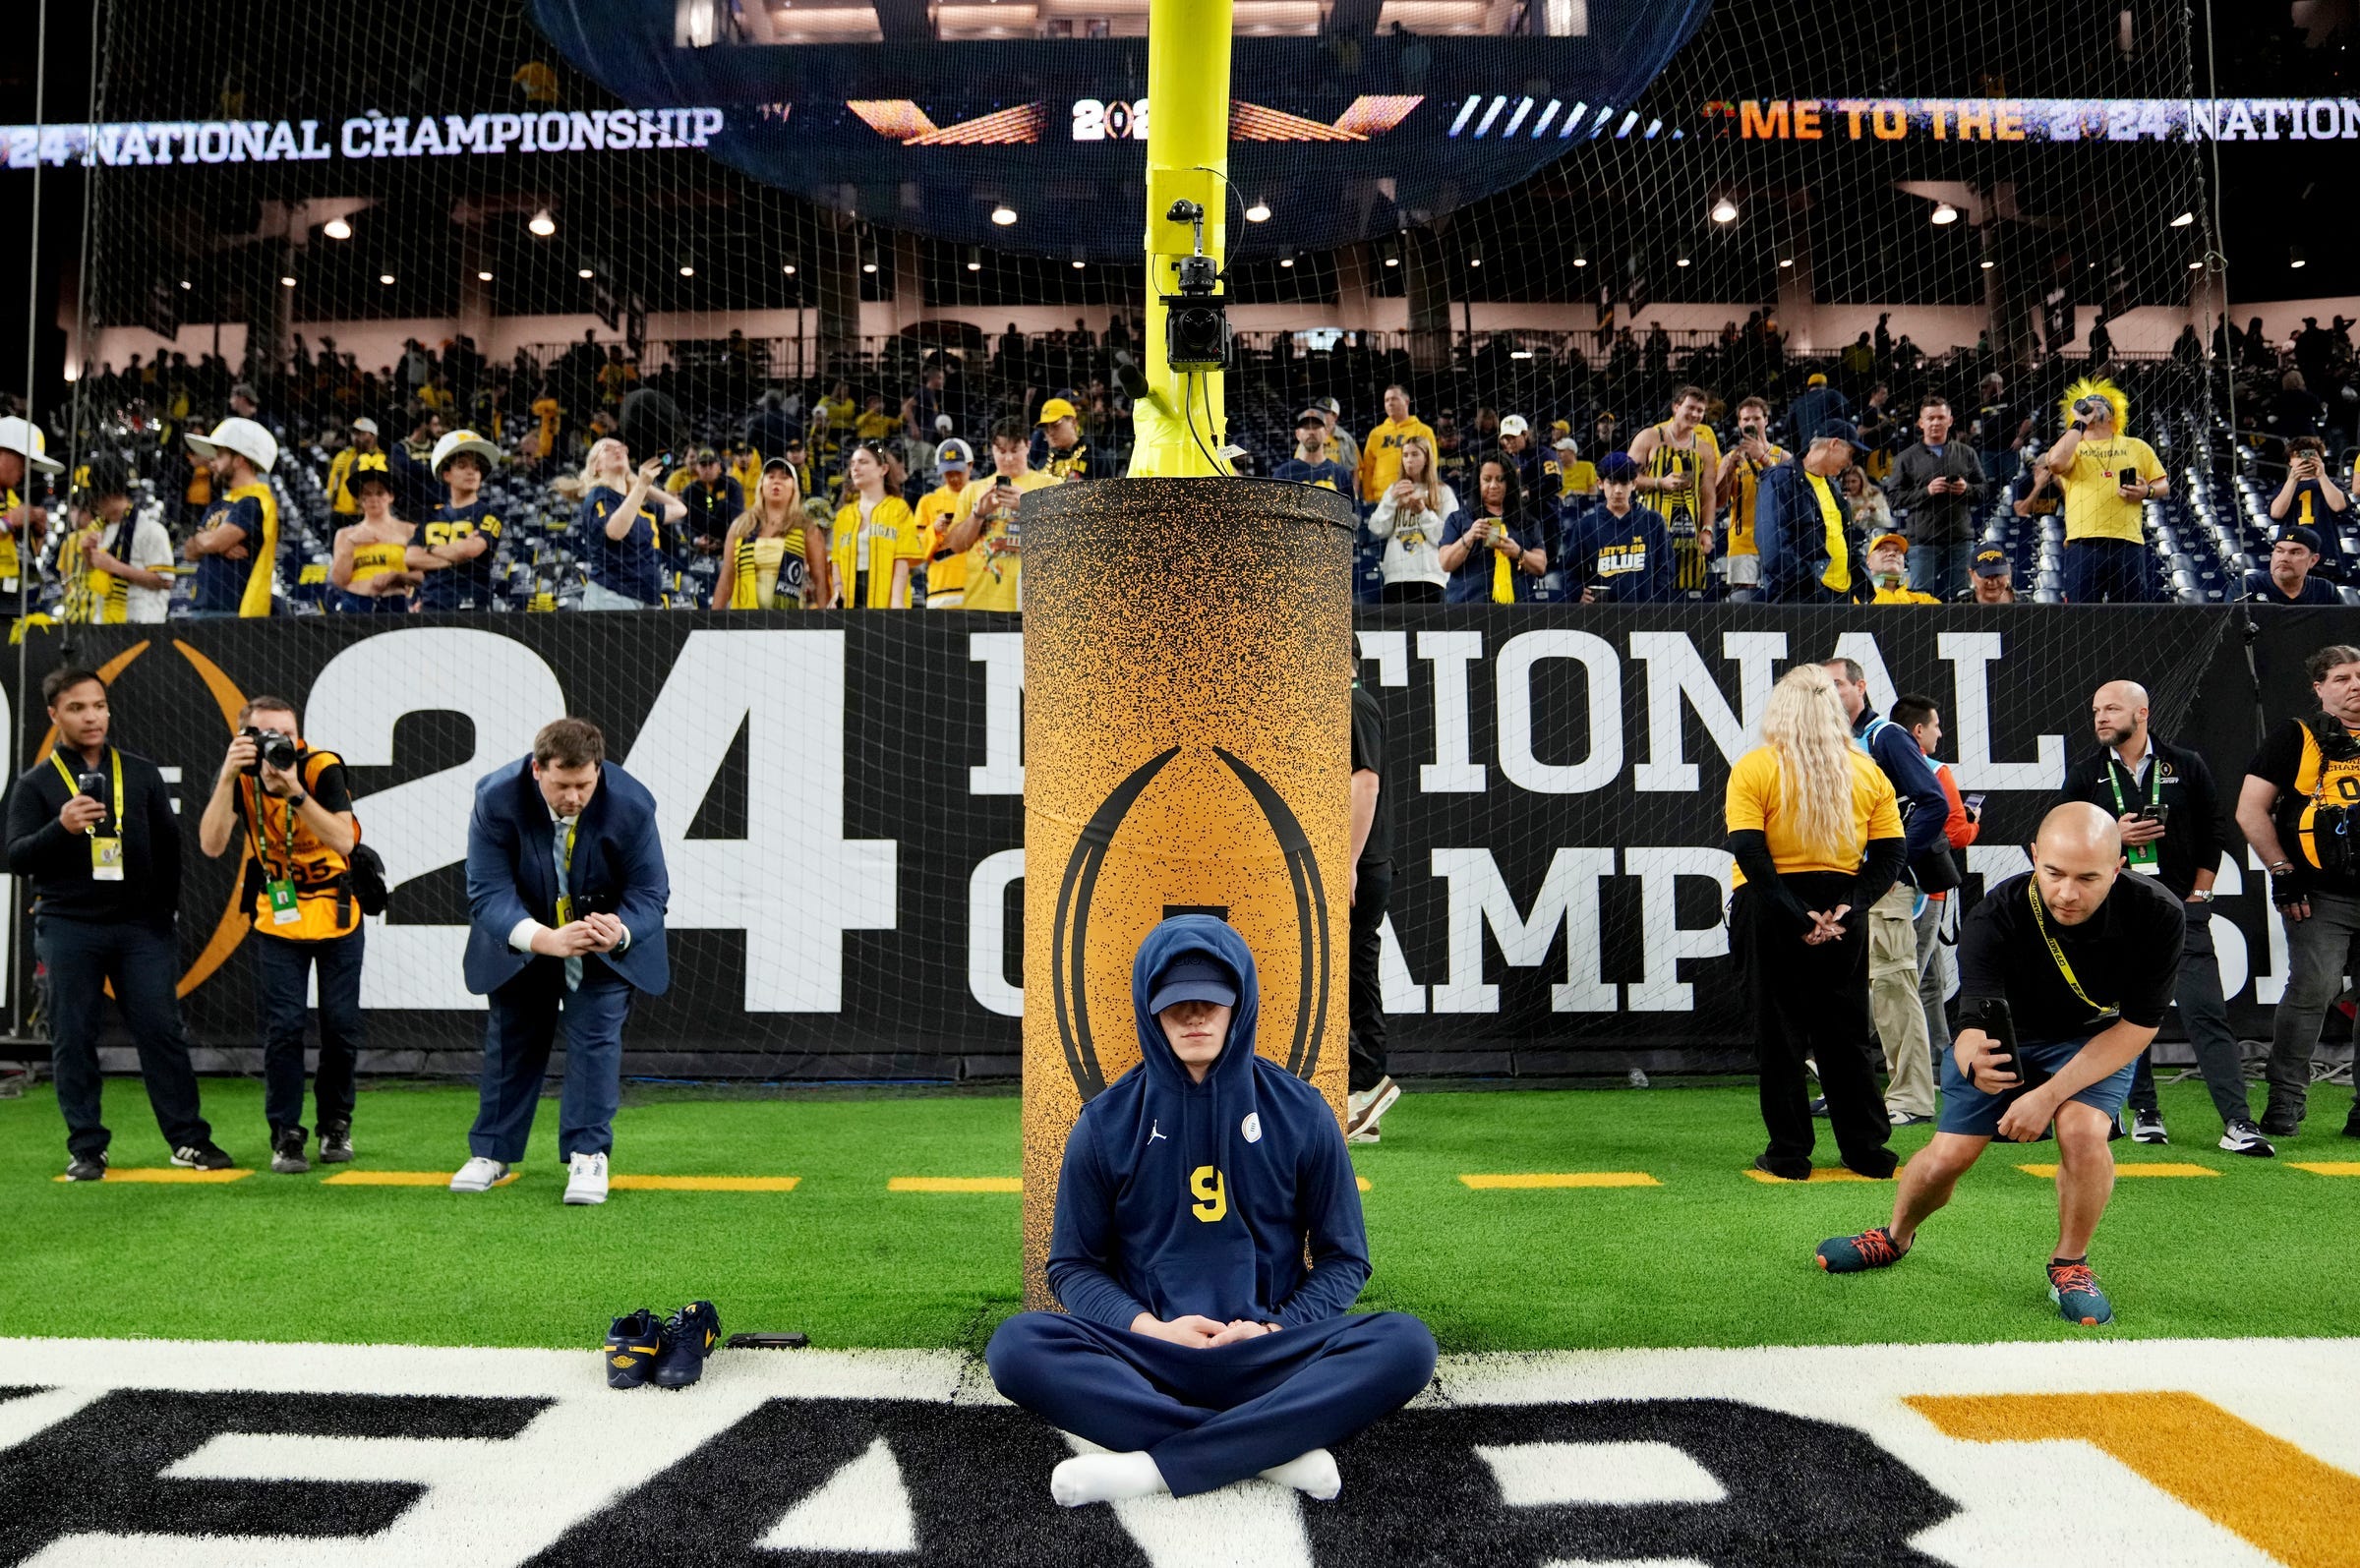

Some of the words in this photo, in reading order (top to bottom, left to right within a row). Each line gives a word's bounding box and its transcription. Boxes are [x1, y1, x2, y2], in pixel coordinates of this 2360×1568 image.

[82, 119, 331, 166] NATIONAL
[341, 107, 724, 158] CHAMPIONSHIP
[1839, 100, 1908, 140] TO
[1923, 100, 2026, 141] THE
[2298, 490, 2316, 525] 1
[1597, 552, 1646, 572] BLUE
[1599, 545, 1627, 557] LET'S
[1630, 544, 1646, 554] GO
[1190, 1165, 1227, 1223] 9
